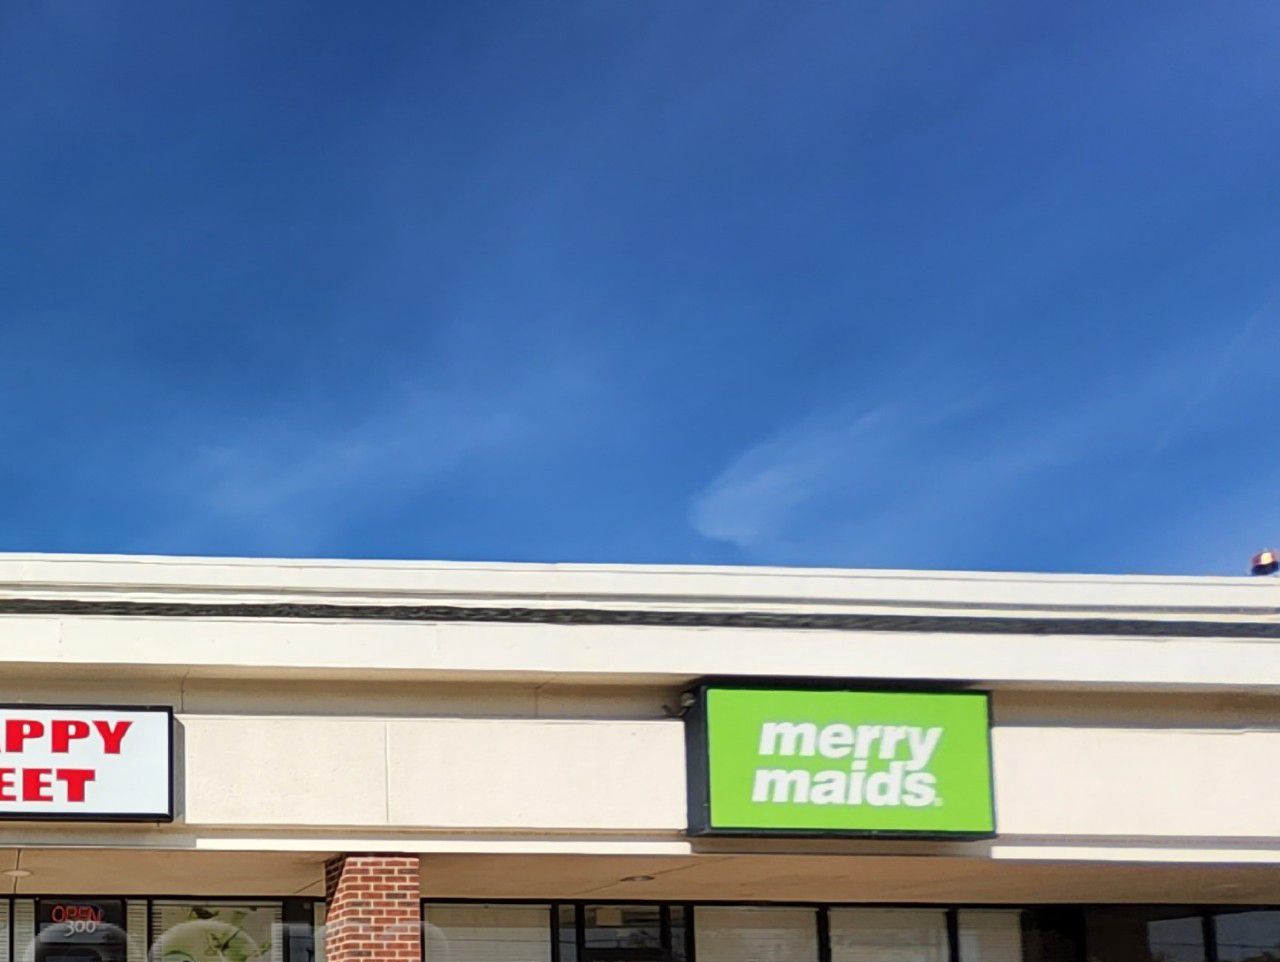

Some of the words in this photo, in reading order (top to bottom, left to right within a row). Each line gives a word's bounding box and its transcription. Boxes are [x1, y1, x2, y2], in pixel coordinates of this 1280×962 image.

[759, 721, 943, 771] merry
[752, 760, 937, 807] maids
[51, 905, 101, 922] OPEN
[64, 920, 96, 937] 300
